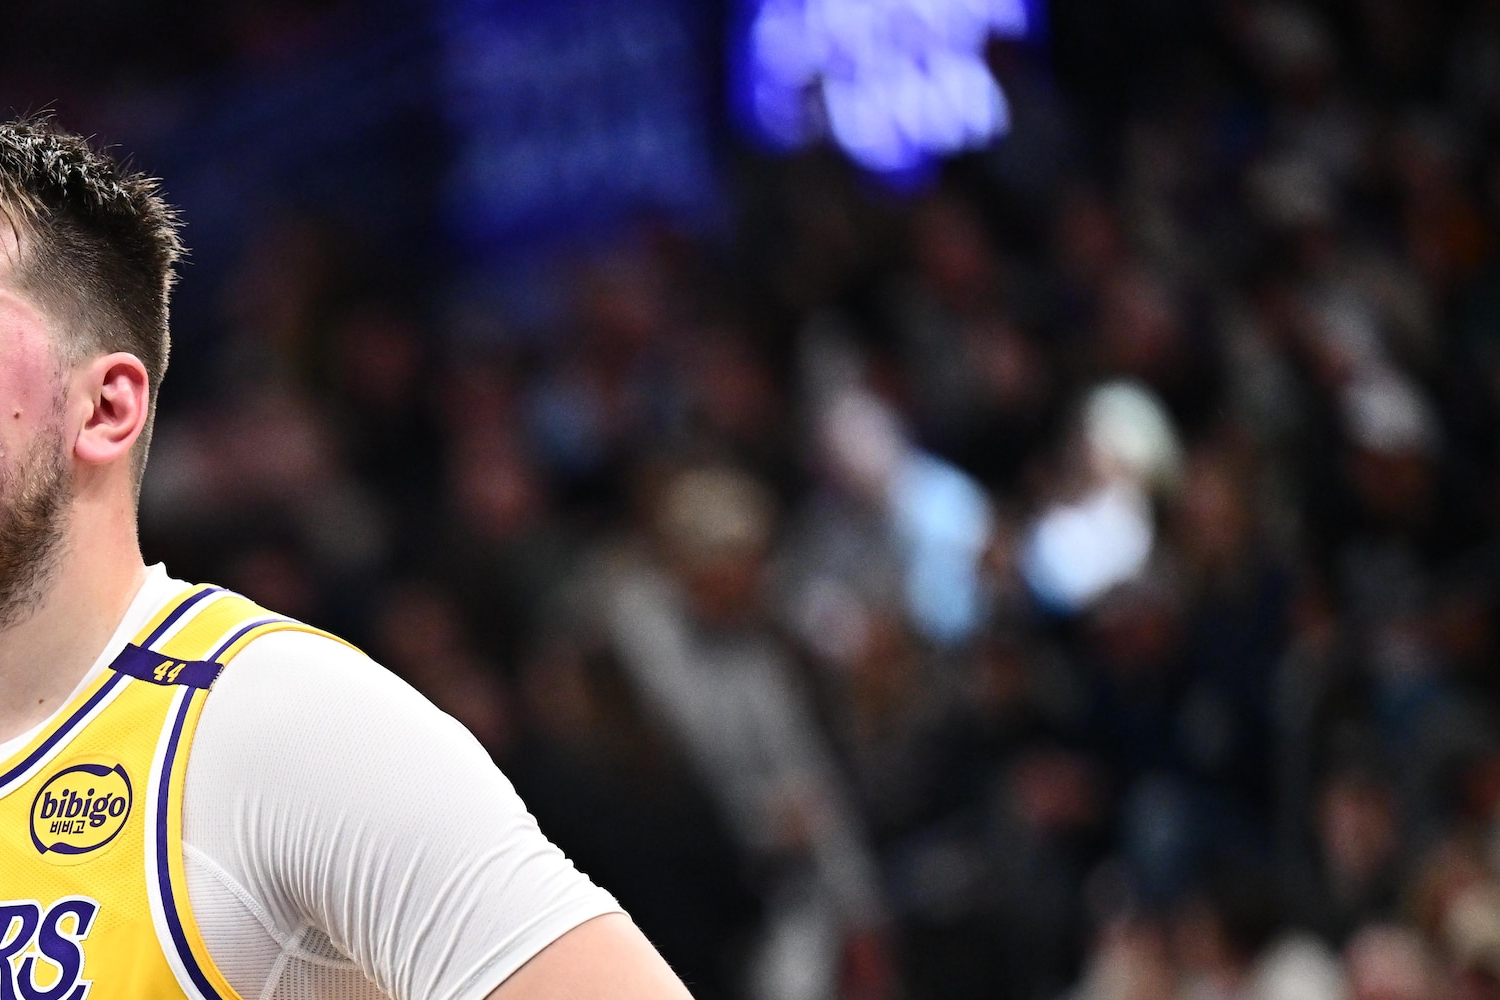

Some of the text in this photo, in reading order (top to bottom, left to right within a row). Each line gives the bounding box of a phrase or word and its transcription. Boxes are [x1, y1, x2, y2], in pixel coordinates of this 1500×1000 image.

[153, 660, 186, 682] 44
[40, 788, 125, 828] bibigo
[49, 820, 85, 835] 비비고
